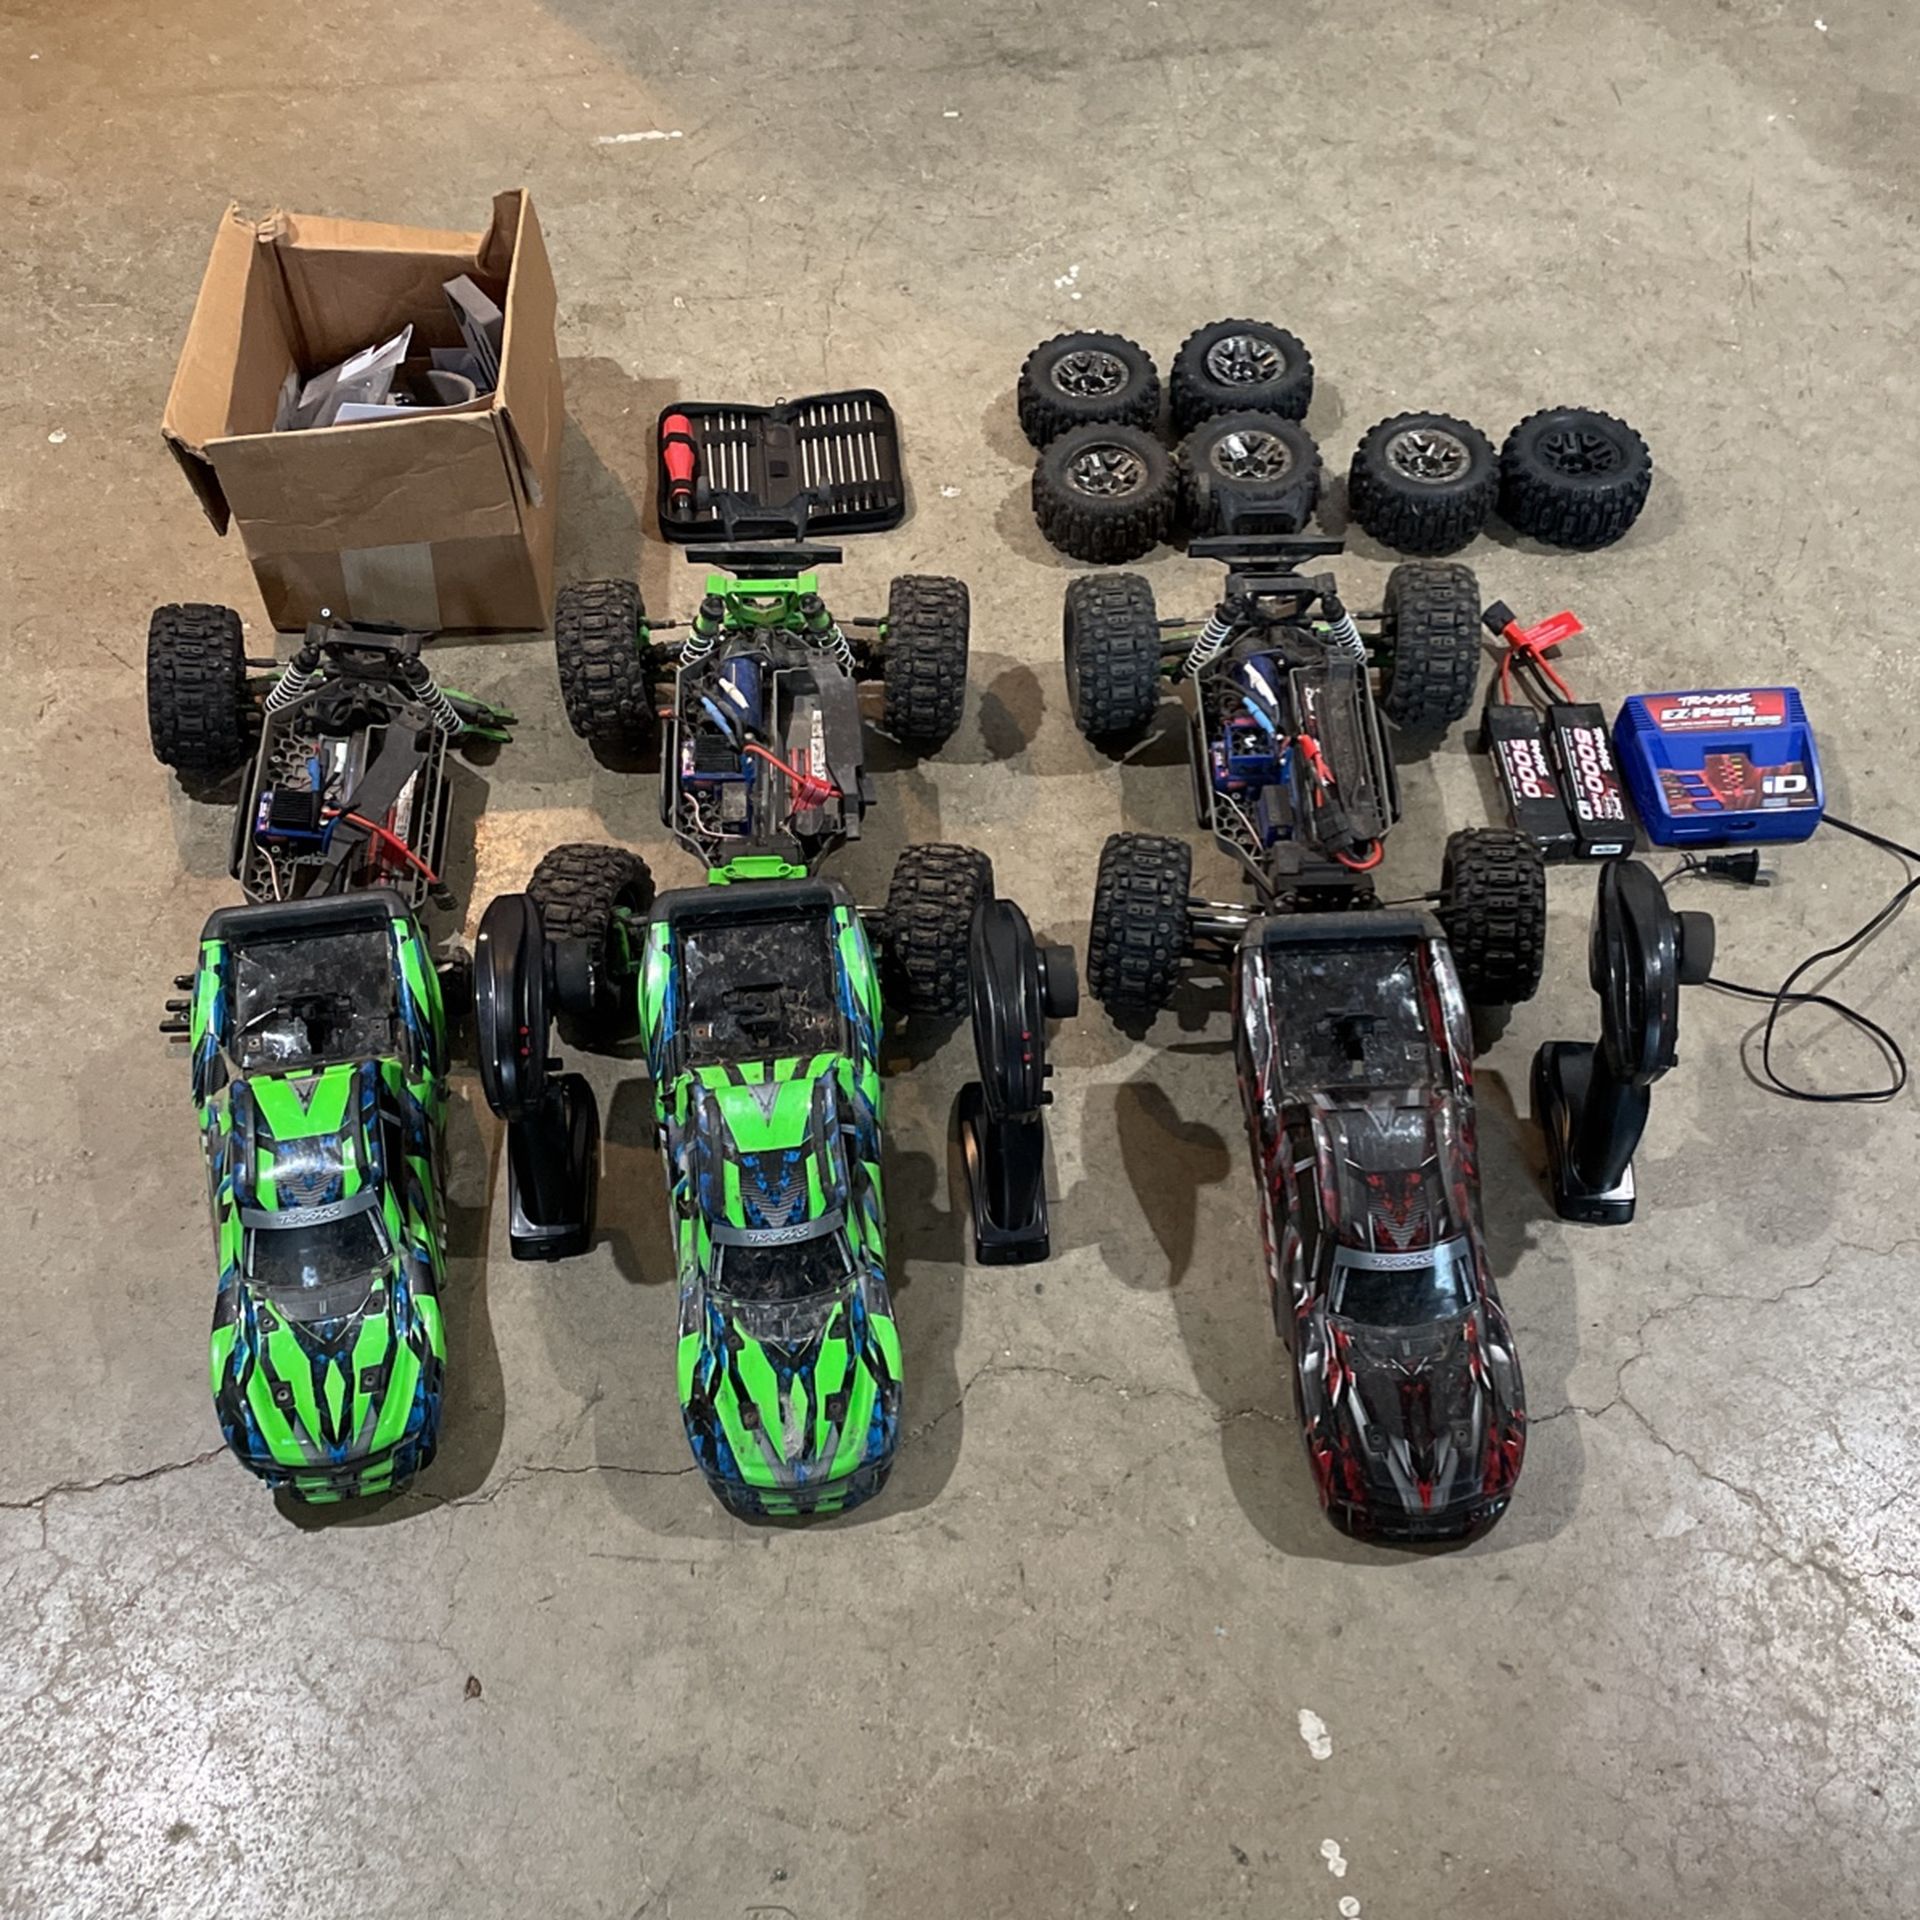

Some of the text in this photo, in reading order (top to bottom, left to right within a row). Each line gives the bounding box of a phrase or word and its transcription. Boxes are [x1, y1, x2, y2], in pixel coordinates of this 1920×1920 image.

[1677, 693, 1752, 706] TRAXXAS
[1510, 739, 1541, 798] 5000
[278, 1206, 340, 1224] TRAXXAS
[749, 1227, 809, 1242] TRAXXAS
[1372, 1254, 1434, 1268] TRAXXAS
